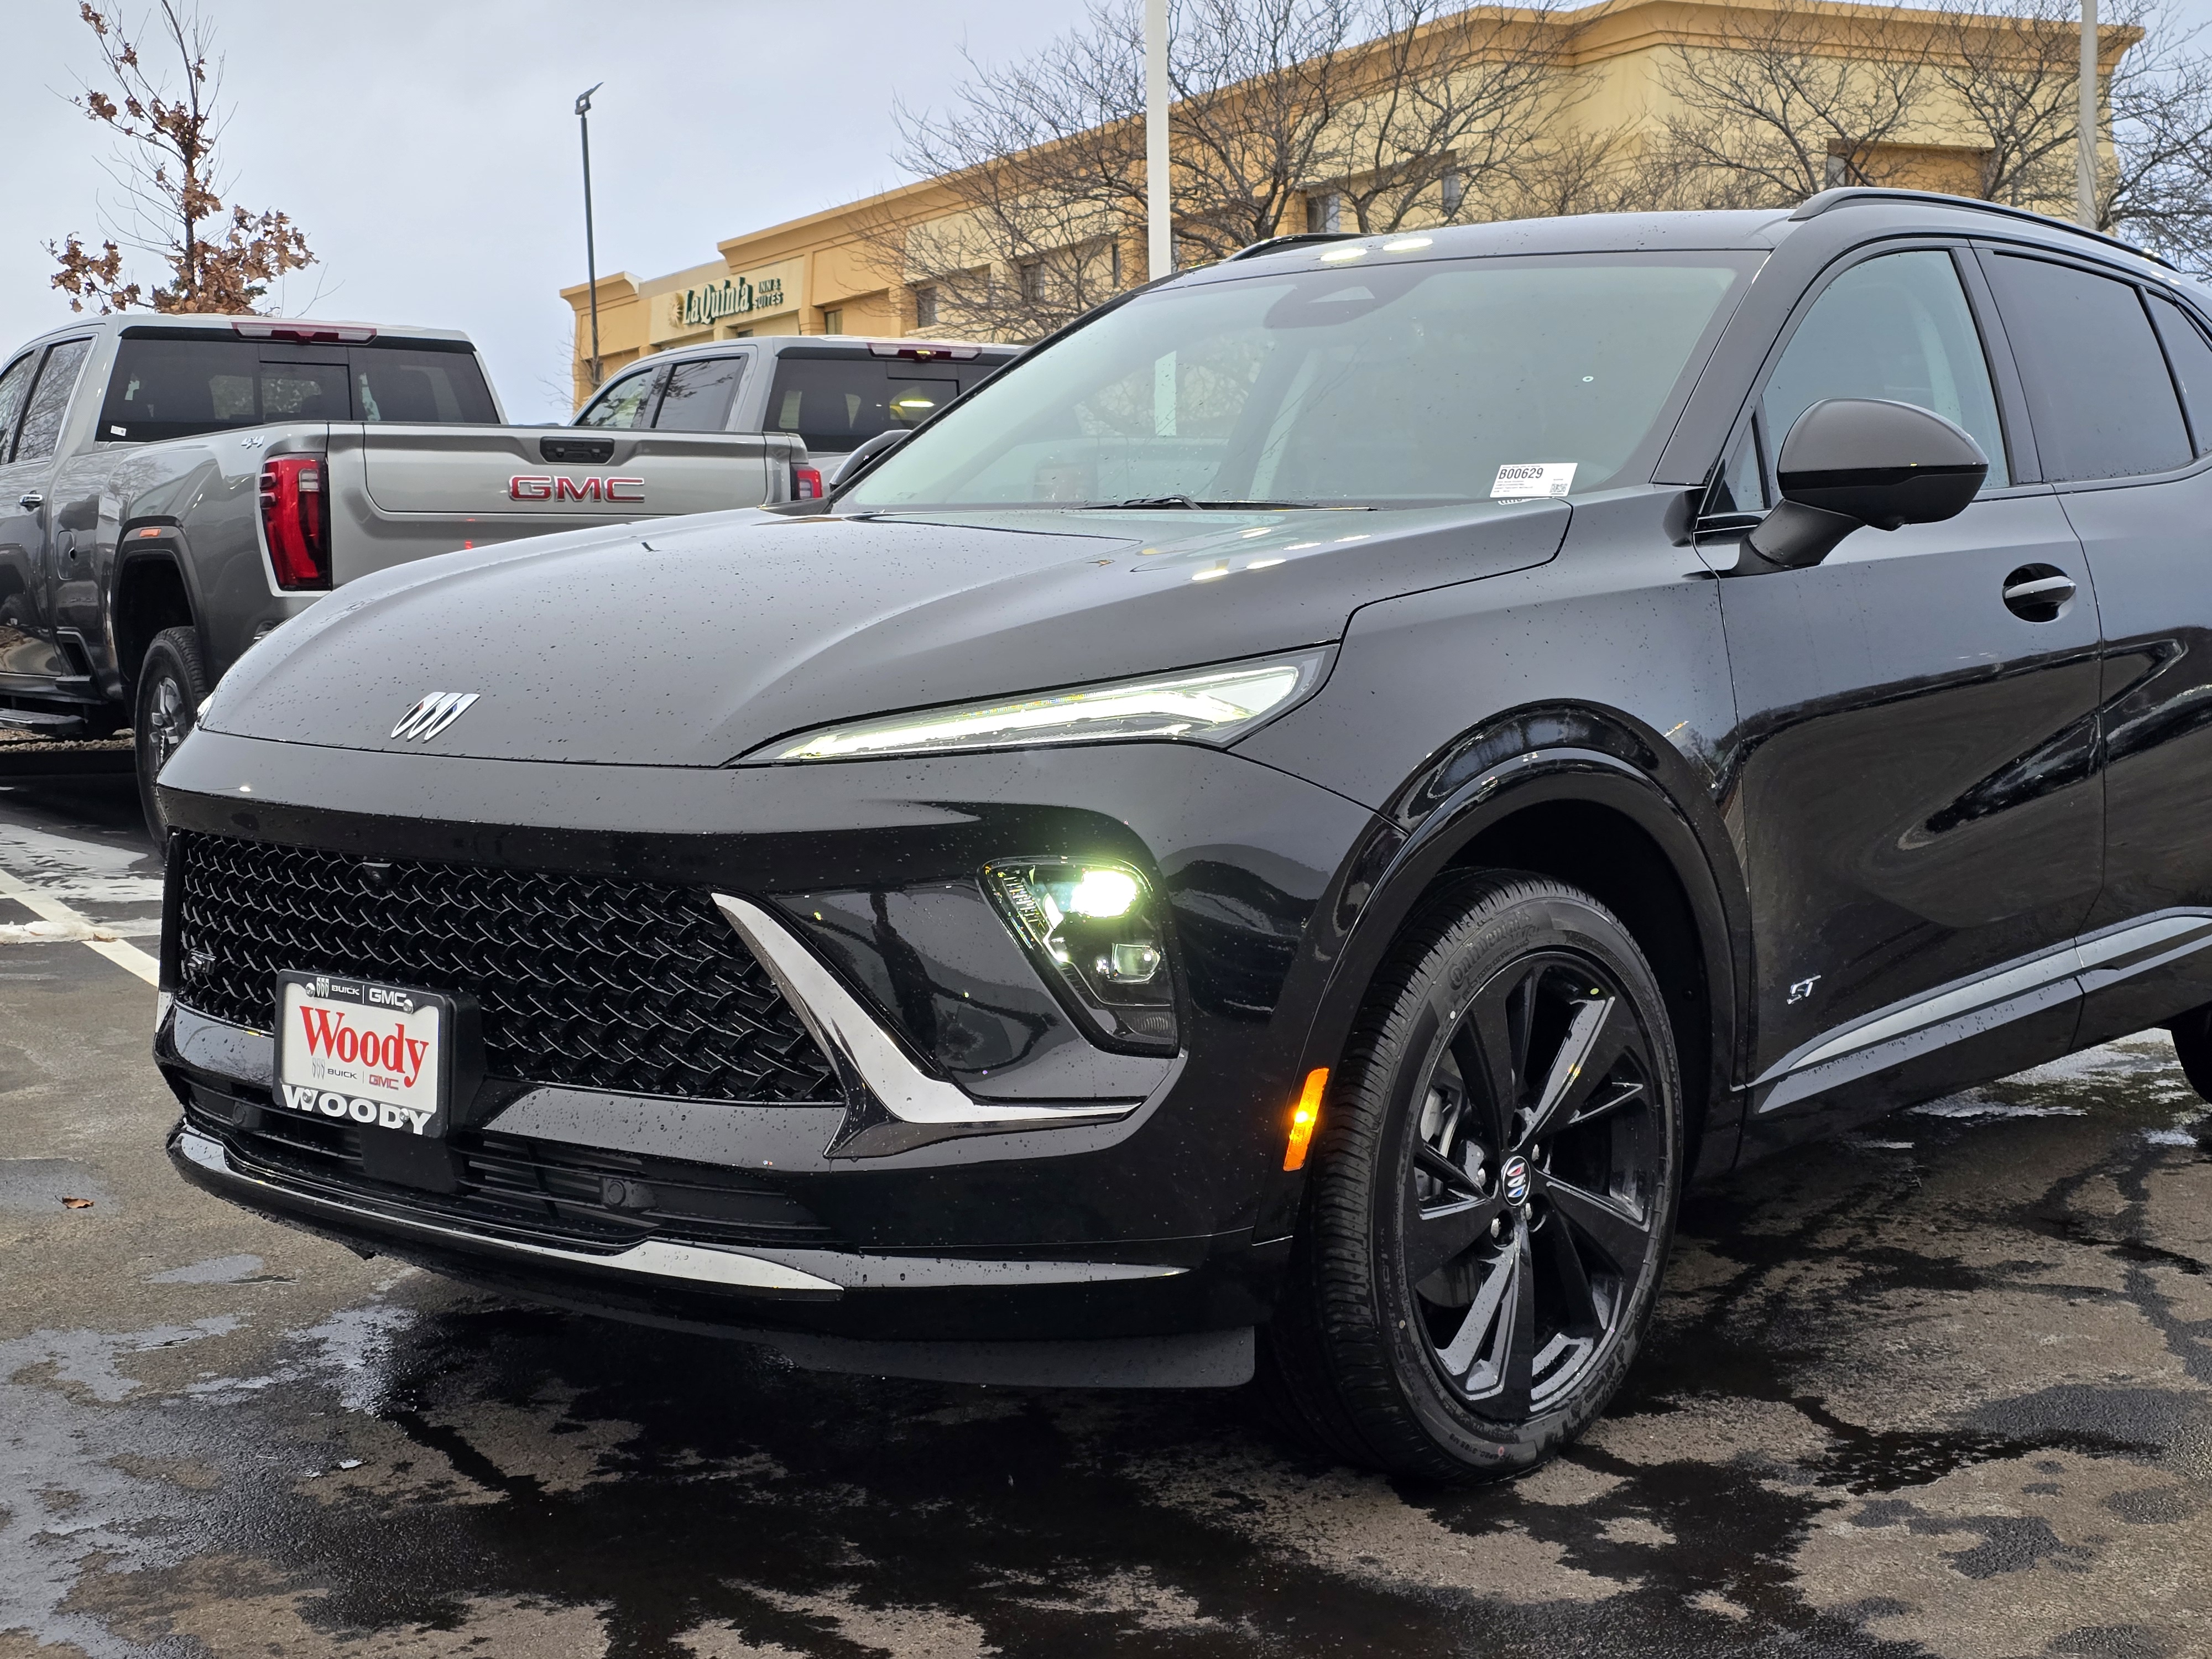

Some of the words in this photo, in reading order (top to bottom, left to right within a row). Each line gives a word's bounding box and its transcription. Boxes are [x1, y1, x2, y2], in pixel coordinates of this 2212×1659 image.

[759, 279, 773, 293] INN
[754, 291, 784, 308] SUITES
[1498, 468, 1543, 479] B00629
[509, 476, 645, 503] GMC
[332, 984, 360, 995] BUICK
[369, 988, 408, 1006] GMC
[299, 1005, 429, 1088] Woody
[327, 1068, 357, 1079] BUICK
[369, 1074, 399, 1091] GMC
[281, 1084, 432, 1135] WOODY
